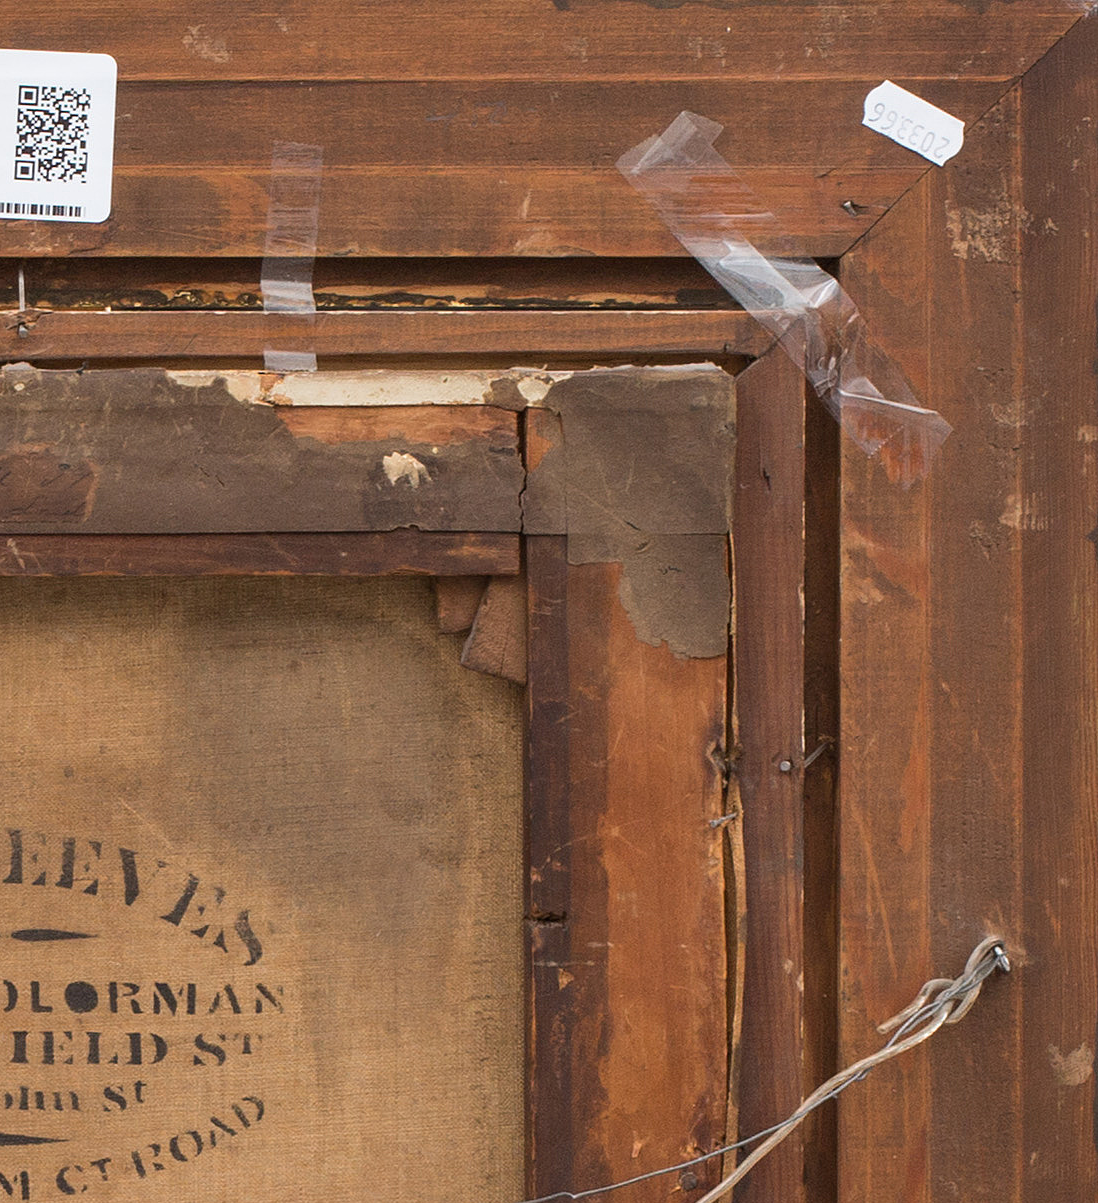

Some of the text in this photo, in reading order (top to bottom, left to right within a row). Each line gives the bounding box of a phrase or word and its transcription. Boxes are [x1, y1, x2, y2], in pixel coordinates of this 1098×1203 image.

[103, 1080, 147, 1112] St
[55, 1157, 112, 1195] CT
[131, 1096, 265, 1179] ROAD
